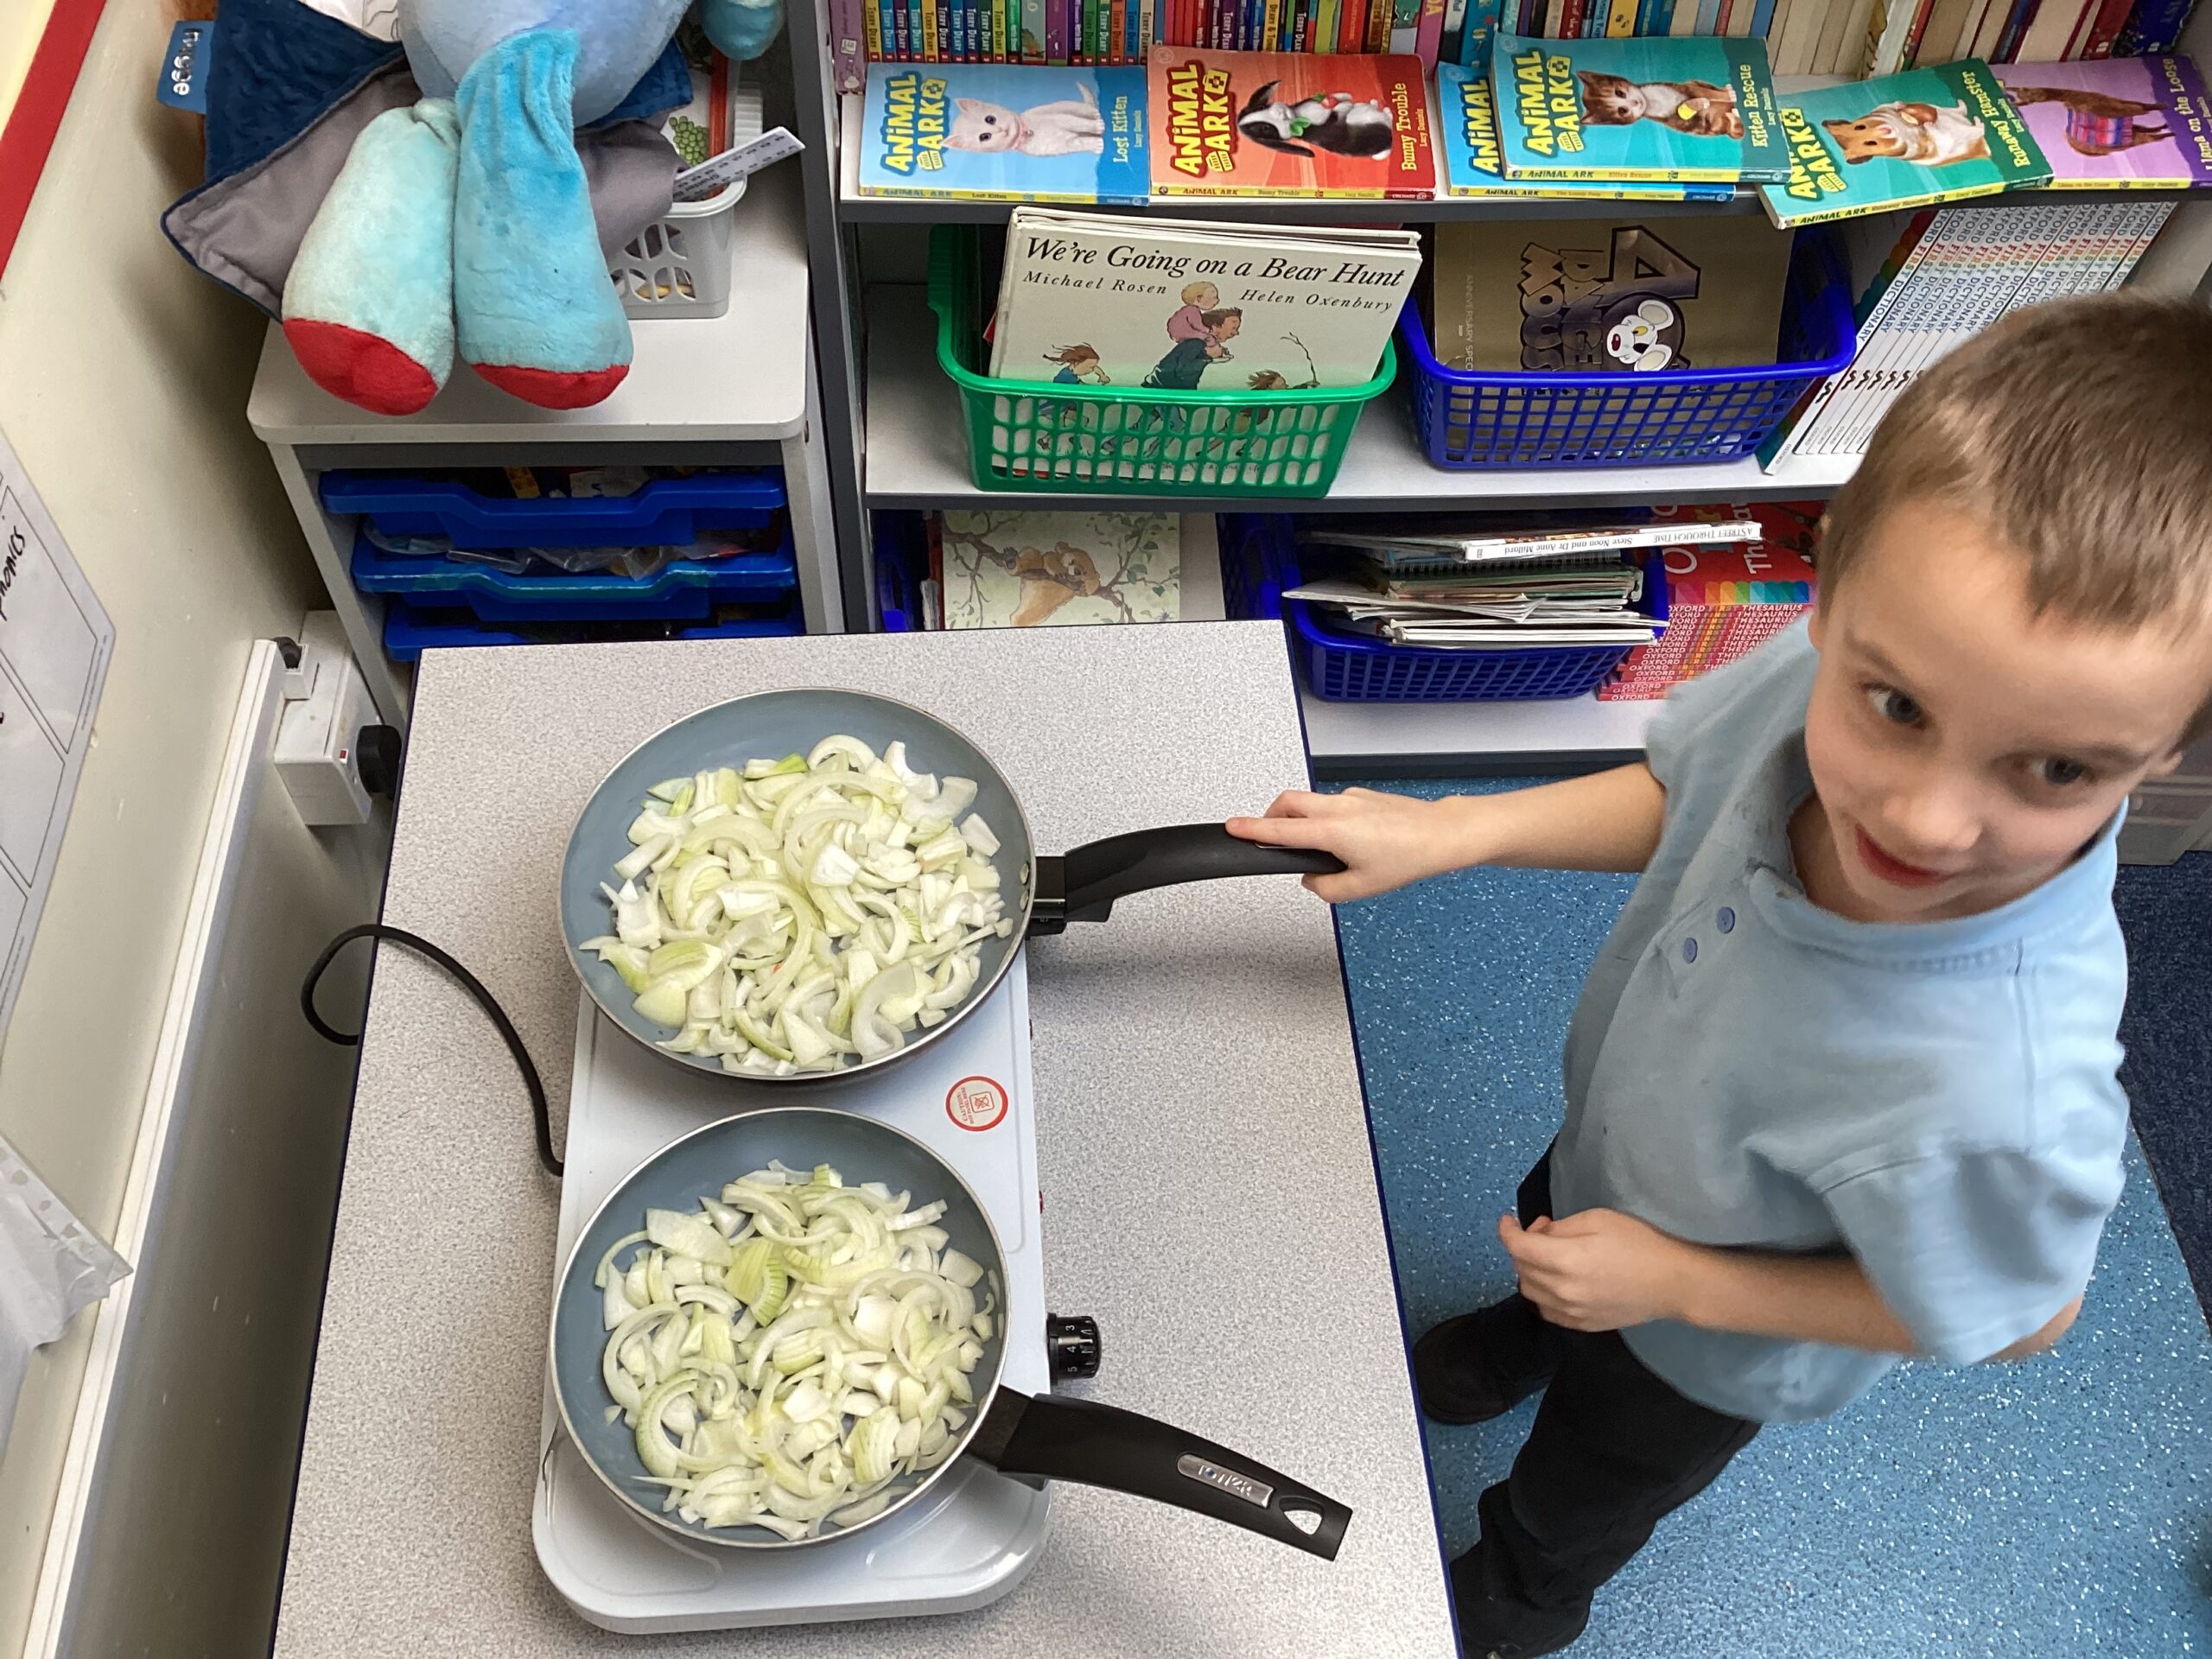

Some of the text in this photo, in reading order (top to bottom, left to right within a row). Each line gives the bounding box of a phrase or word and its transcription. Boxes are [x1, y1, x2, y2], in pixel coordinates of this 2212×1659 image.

[882, 10, 893, 48] TERRY DEARY
[897, 10, 907, 48] TERRY DEARY
[911, 9, 921, 48] TERRY DEARY
[938, 7, 948, 48] TERRY DEARY
[952, 10, 963, 51] TERRY DEARY
[967, 9, 976, 49] TERRY DEARY
[982, 10, 990, 51] TERRY DEARY
[1100, 10, 1109, 52] TERRY DEARY
[1224, 12, 1233, 32] TERRY
[1297, 12, 1306, 33] TERRY
[1548, 76, 1580, 131] ARK
[1740, 64, 1769, 148] Kitten Rescue
[1962, 71, 1999, 118] Hamster
[2163, 58, 2202, 132] on the Loose
[918, 99, 944, 150] ARK
[1111, 96, 1129, 162] Lost Kitten
[1203, 92, 1231, 151] ARK
[1391, 82, 1417, 171] Bunny Trouble
[1415, 108, 1428, 147] Lucy Daniels
[1768, 111, 1777, 126] Lucy
[2011, 118, 2024, 133] Lucy
[1134, 133, 1144, 148] Lucy
[1787, 126, 1835, 173] ARK
[1991, 120, 2031, 168] Runaway
[1800, 207, 1868, 224] ANIMAL ARK
[1025, 235, 1405, 289] We're Going on a Bear Hunt
[1901, 245, 1928, 278] FIRST
[1920, 243, 1945, 274] FIRST
[1935, 244, 1960, 275] FIRST
[1949, 245, 1974, 275] FIRST
[1963, 246, 1989, 276] FIRST
[1977, 245, 2003, 275] FIRST
[1991, 245, 2018, 275] FIRST
[2006, 243, 2032, 273] FIRST
[2020, 244, 2046, 274] FIRST
[2066, 238, 2091, 268] FIRST
[1023, 270, 1393, 314] Michael Rosen Helen Oxenbury
[2010, 245, 2062, 309] FIRST DICTIO
[2027, 271, 2055, 304] DICTIO
[1520, 242, 1564, 380] MOUS
[1559, 249, 1604, 380] DANGE
[1859, 279, 1904, 342] DICTIONARY
[1880, 275, 1924, 334] DICTIONARY
[1896, 276, 1939, 333] DICTIONARY
[1908, 276, 1952, 334] DICTIONARY
[1922, 277, 1967, 334] DICTIONARY
[1936, 276, 1980, 334] DICTIONARY
[1950, 276, 1994, 333] DICTIONARY
[1965, 275, 2010, 332] DICTIONARY
[1504, 544, 1535, 555] Millard
[1536, 543, 1556, 552] Anne
[1559, 543, 1568, 551] Dr
[1572, 541, 1586, 550] and
[1590, 539, 1610, 548] Noon
[1612, 537, 1632, 546] Steve
[1653, 533, 1672, 543] TIME
[1675, 531, 1714, 541] THROUGH
[1718, 529, 1747, 538] STREET
[0, 524, 25, 621] onics
